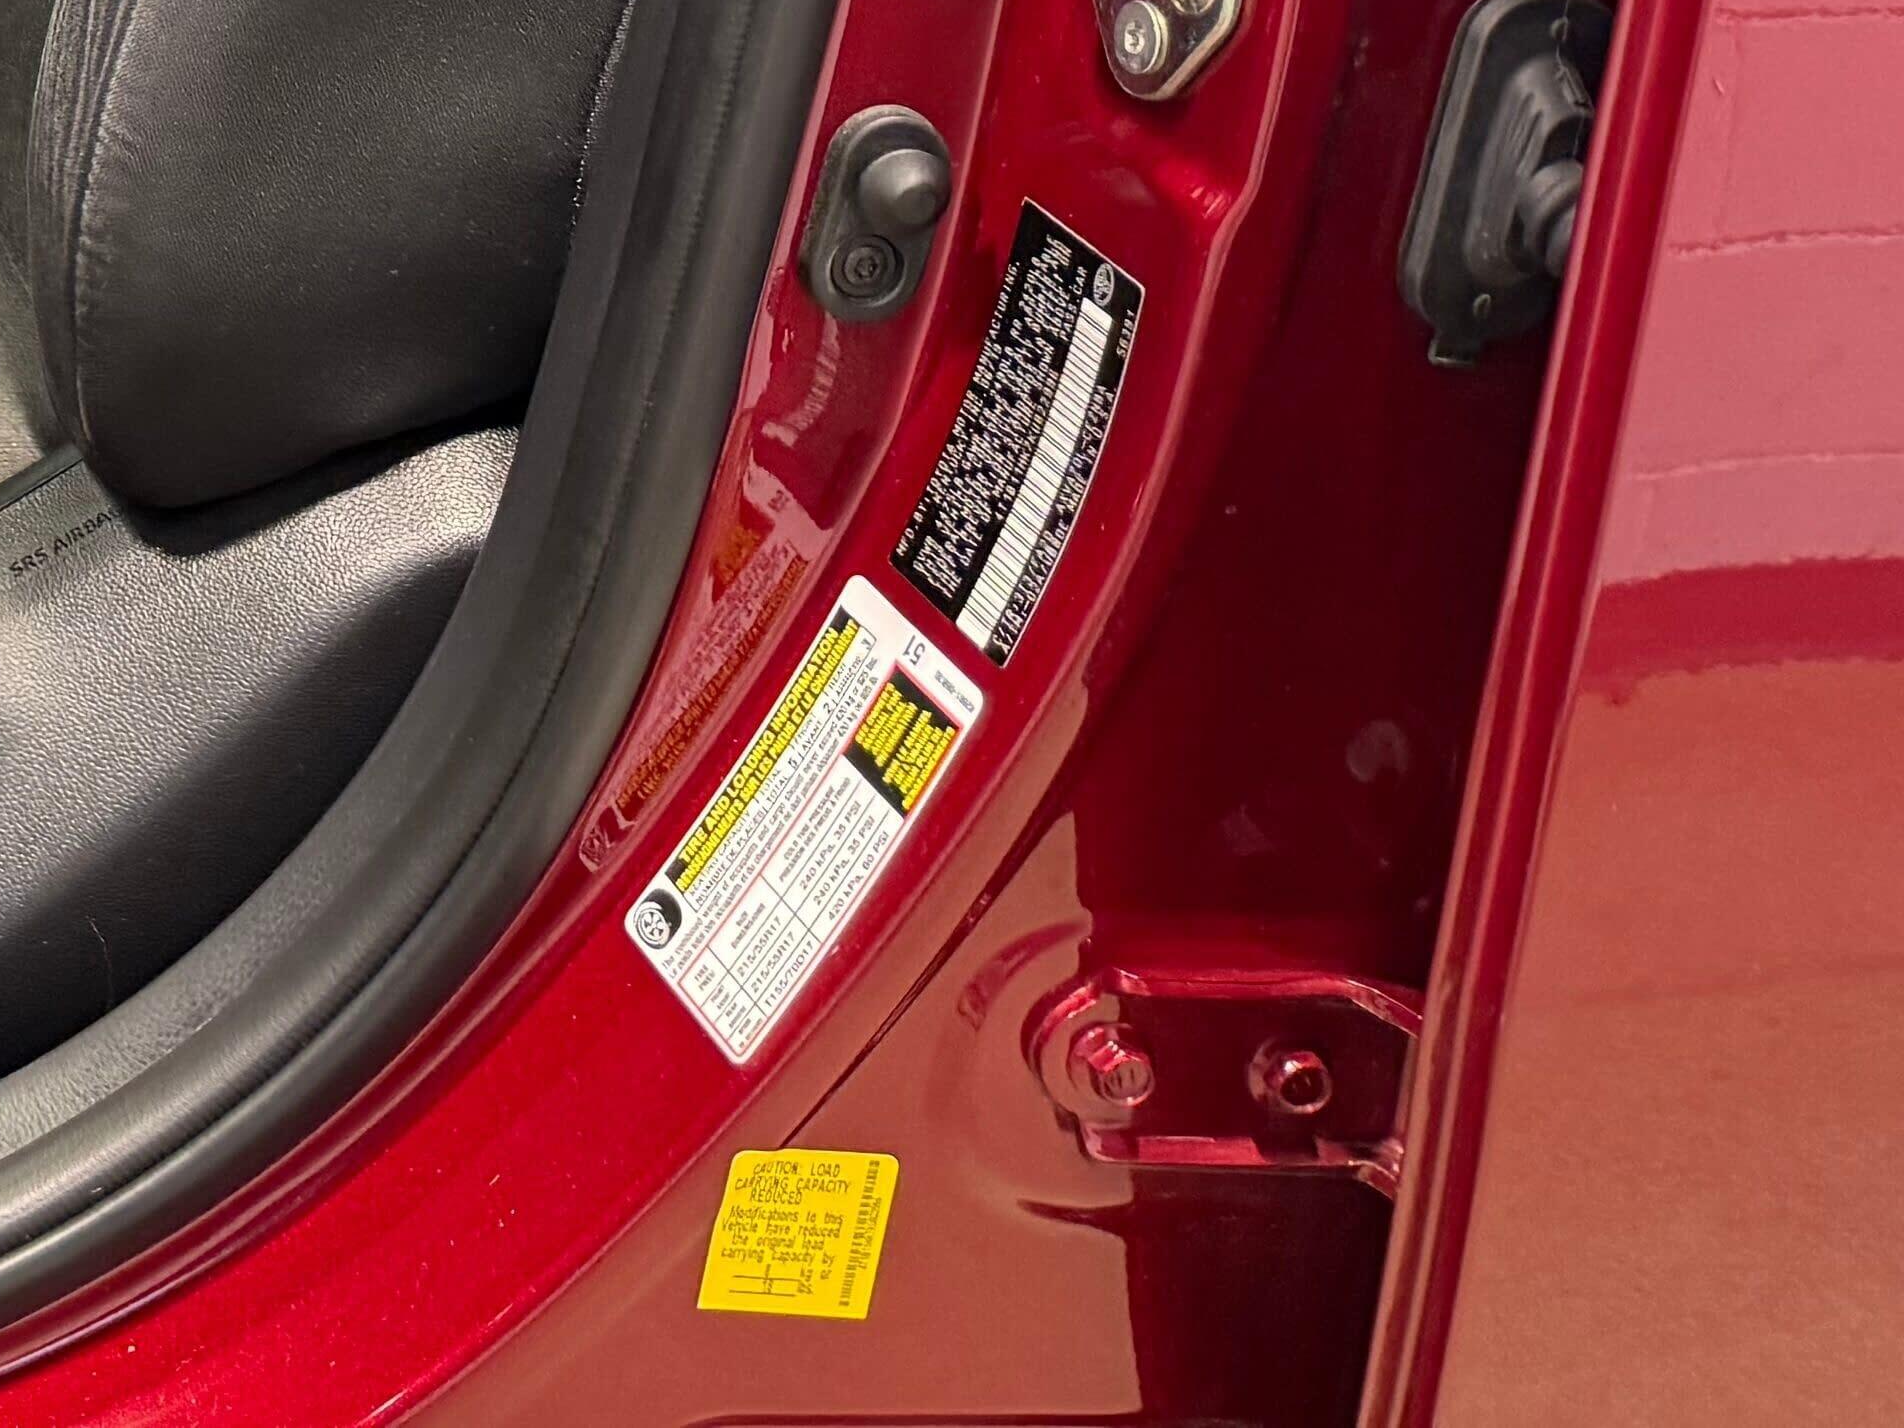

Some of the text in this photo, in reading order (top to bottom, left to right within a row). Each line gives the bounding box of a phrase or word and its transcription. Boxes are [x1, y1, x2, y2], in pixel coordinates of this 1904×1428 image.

[9, 547, 48, 577] SRS
[808, 617, 859, 695] CHARGEMENT
[901, 633, 927, 666] 51
[801, 701, 833, 752] AVANT 2
[678, 825, 708, 864] TIRE
[702, 793, 731, 831] AND
[725, 728, 775, 798] LOADING
[769, 626, 839, 732] INFORMATION
[798, 865, 818, 891] 240
[832, 822, 847, 841] 35
[843, 799, 862, 824] PSI
[812, 881, 832, 906] 240
[846, 837, 861, 855] 35
[857, 814, 876, 839] PSI
[826, 896, 845, 921] 420
[871, 829, 890, 853] PSI
[735, 1176, 849, 1193] CARRYING CAPACITY
[811, 1164, 840, 1178] LOAD
[730, 1205, 799, 1222] Modifications
[750, 1189, 802, 1205] REDUCED
[798, 1224, 842, 1239] reduced
